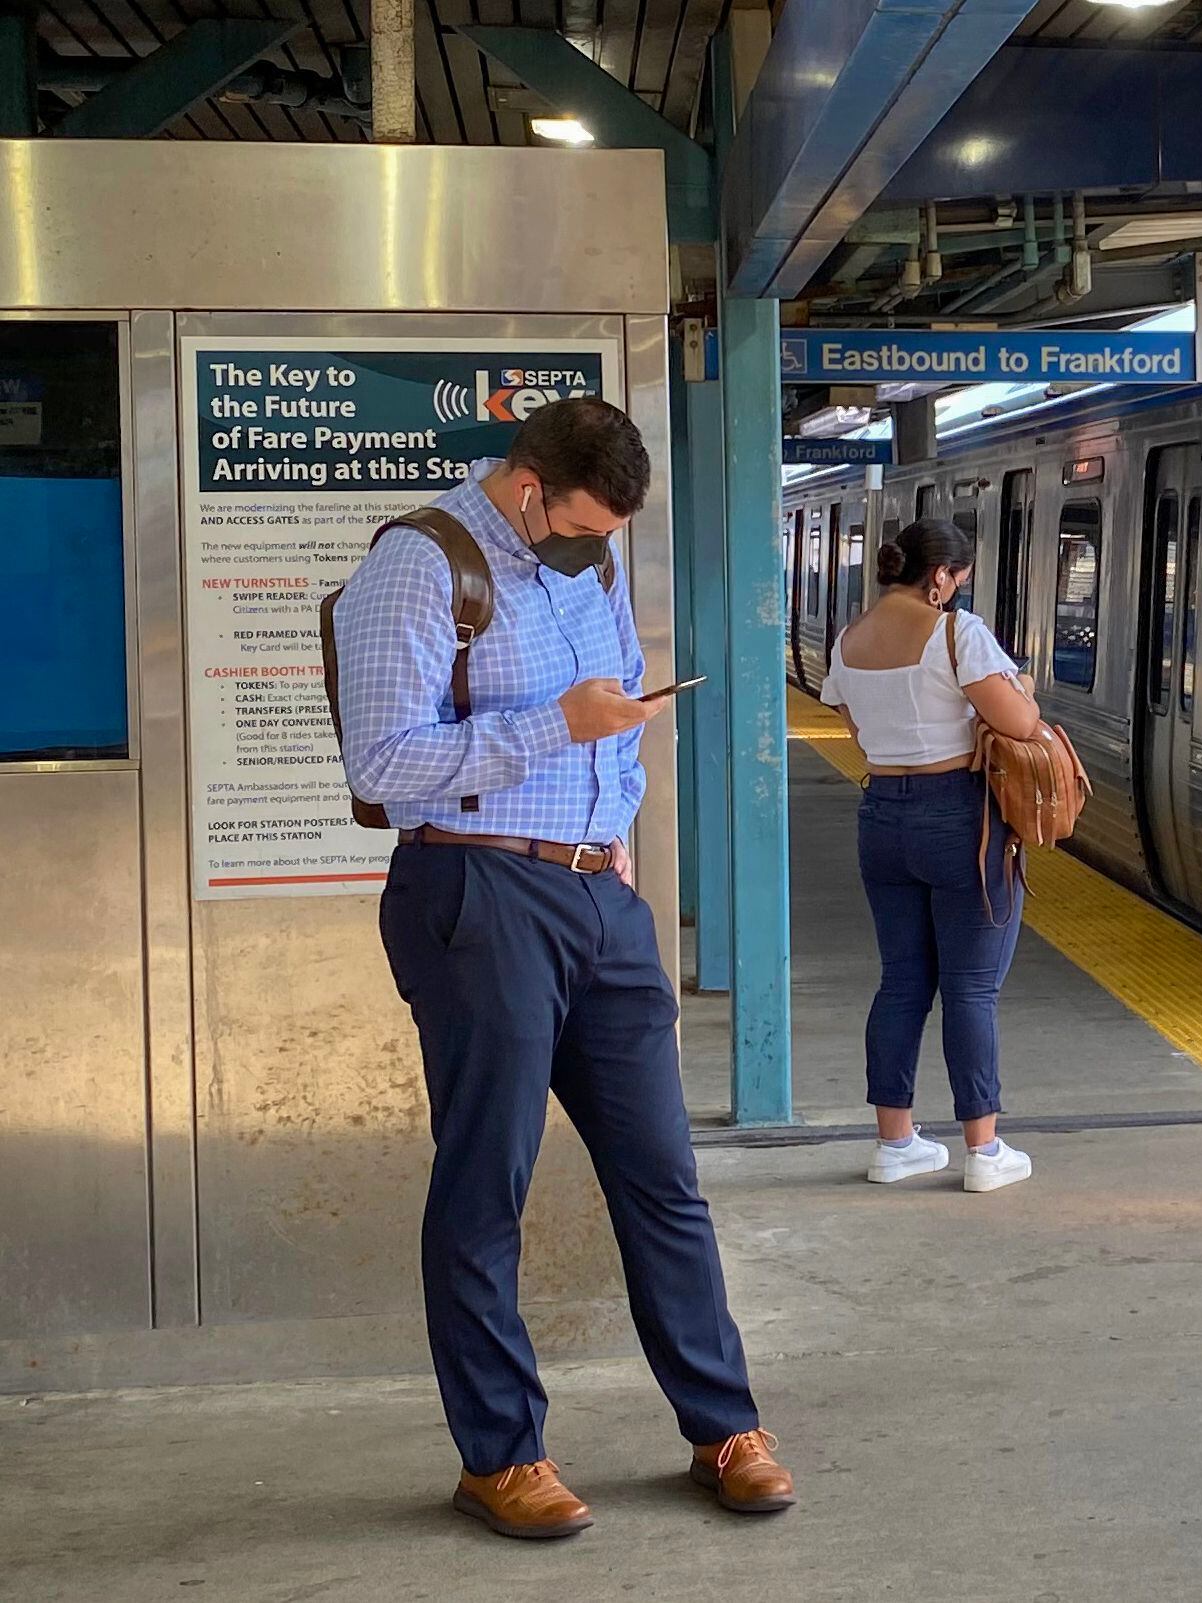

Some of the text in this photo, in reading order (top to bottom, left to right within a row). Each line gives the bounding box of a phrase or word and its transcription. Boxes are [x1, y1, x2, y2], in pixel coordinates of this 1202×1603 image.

[822, 343, 1181, 374] Eastbound to Frankford
[210, 363, 355, 391] The Key to
[525, 371, 586, 386] SEPTA
[476, 370, 585, 422] ke
[211, 395, 355, 418] the Future
[212, 426, 436, 454] of Fare Payment
[796, 445, 876, 459] Frankford
[212, 457, 474, 486] Arriving at this Sta
[200, 504, 215, 512] We
[235, 504, 295, 514] modernizing
[298, 503, 313, 512] the
[316, 503, 351, 511] fareline
[365, 503, 382, 511] this
[384, 503, 416, 511] station
[200, 517, 223, 525] AND
[226, 516, 264, 525] ACCESS
[267, 516, 299, 524] GATES
[314, 517, 333, 526] part
[336, 516, 346, 524] of
[348, 516, 364, 524] the
[201, 543, 219, 551] The
[243, 542, 296, 552] equipment
[299, 541, 316, 550] will
[317, 542, 335, 550] not
[201, 554, 230, 563] where
[233, 554, 283, 563] customers
[285, 554, 311, 564] using
[313, 553, 348, 562] Tokens
[202, 578, 349, 589] NEW TURNSTILES Famil
[232, 592, 264, 601] SWIPE
[266, 592, 308, 600] READER:
[233, 605, 269, 614] Citizens
[271, 605, 291, 613] with
[301, 605, 313, 613] PA
[233, 630, 321, 639] RED FRAMED VAL
[240, 644, 257, 653] Key
[259, 643, 280, 651] Card
[283, 643, 299, 651] will
[204, 666, 324, 678] CASHIER BOOTH TR
[235, 682, 278, 690] TOKENS:
[292, 683, 308, 691] pay
[235, 695, 266, 703] CASH:
[268, 694, 292, 702] Exact
[235, 705, 331, 715] TRANSFERS (PRESE
[235, 718, 334, 728] ONE DAY CONVENIE
[236, 733, 264, 741] (Good
[266, 732, 279, 740] for
[290, 731, 312, 739] rides
[236, 743, 314, 753] from this station)
[236, 755, 324, 766] SENIOR/REDUCED
[207, 784, 235, 792] SEPTA
[237, 782, 299, 792] Ambassadors
[300, 781, 316, 789] will
[318, 781, 330, 789] be
[207, 797, 225, 805] fare
[227, 797, 267, 807] payment
[270, 794, 321, 805] equipment
[323, 793, 340, 801] and
[208, 822, 236, 830] LOOK
[238, 820, 258, 829] FOR
[260, 819, 301, 828] STATION
[304, 818, 348, 827] POSTERS
[208, 831, 322, 843] PLACE AT THIS STATION
[208, 855, 390, 869] To learn more about the SEPTA Key prog
